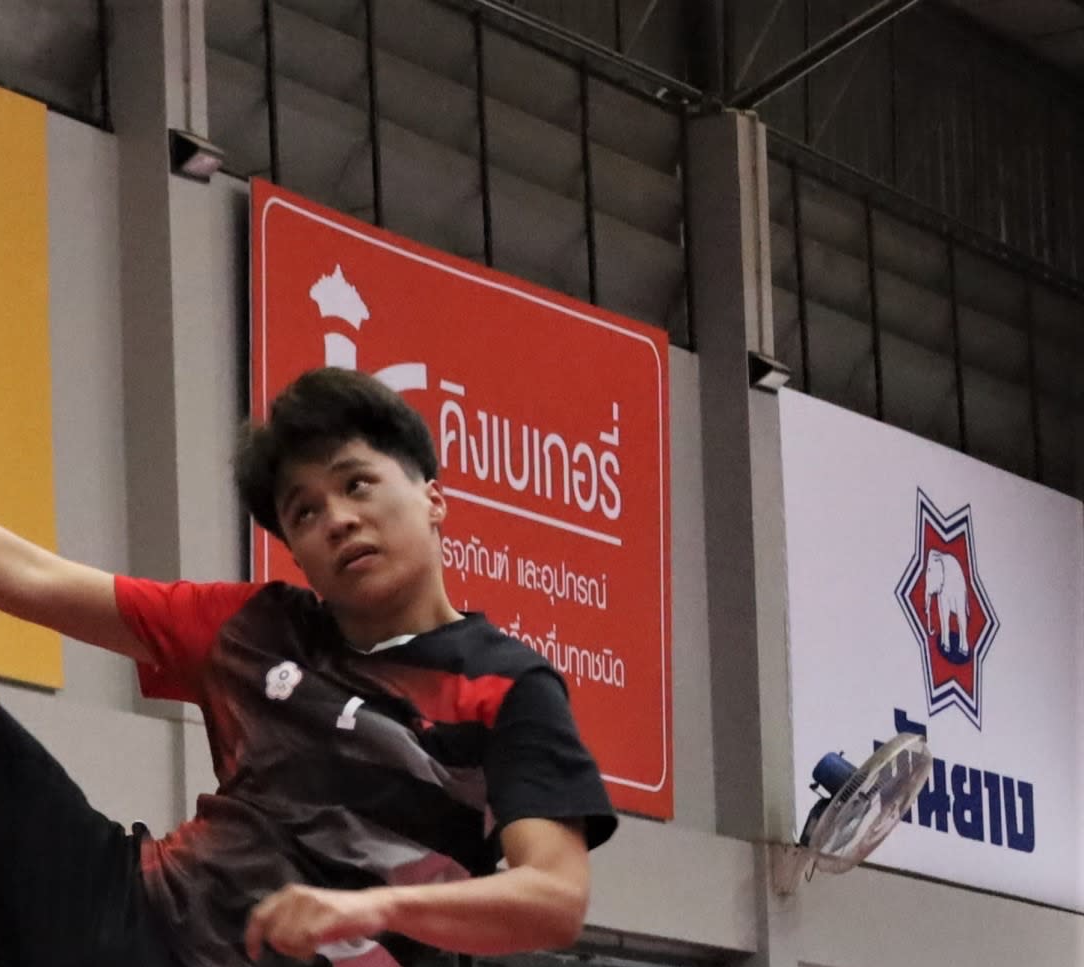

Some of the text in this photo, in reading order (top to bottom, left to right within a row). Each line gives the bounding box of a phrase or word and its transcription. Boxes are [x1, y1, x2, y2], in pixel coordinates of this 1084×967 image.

[439, 379, 622, 521] คิงเบเกอรี่
[441, 535, 607, 610] รจุภัณฑ์ และอุปกรณ์
[873, 708, 1035, 854] ันยาง
